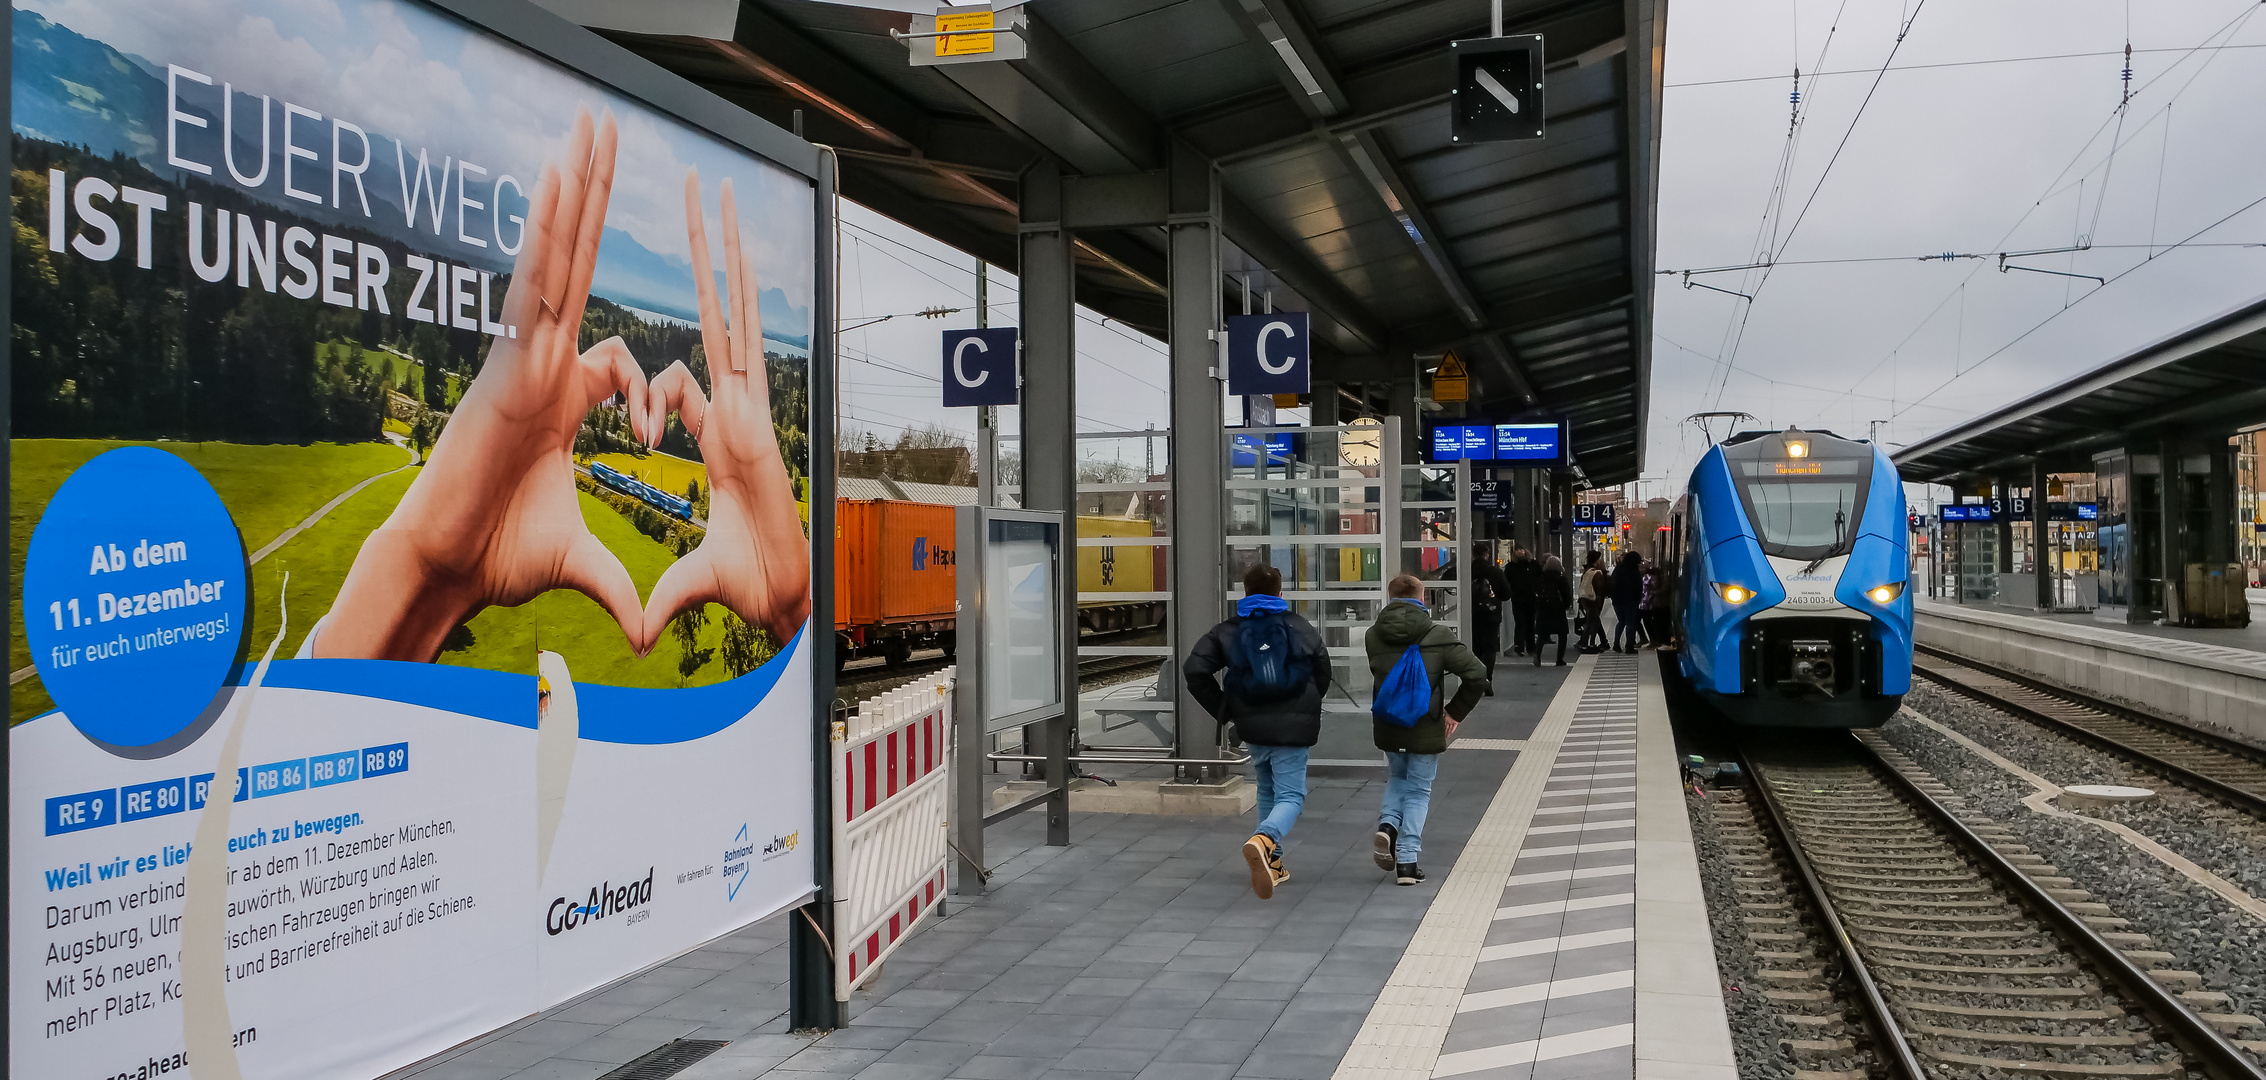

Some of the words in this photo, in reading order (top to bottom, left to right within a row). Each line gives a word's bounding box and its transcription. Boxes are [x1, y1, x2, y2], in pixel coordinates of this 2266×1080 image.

[167, 63, 372, 217] EUER
[394, 138, 526, 256] WEG
[49, 168, 168, 270] IST
[188, 202, 390, 315] UNSER
[405, 253, 517, 338] ZIEL.
[953, 336, 989, 387] C
[1257, 321, 1296, 375] C
[1486, 482, 1498, 491] 27
[1581, 505, 1591, 518] B
[1602, 505, 1611, 518] 4
[1992, 499, 2001, 513] 3
[2014, 499, 2024, 513] B
[1913, 516, 1920, 526] 3
[90, 543, 126, 575] Ab
[133, 539, 187, 568] dem
[50, 598, 91, 630] 11.
[98, 579, 225, 622] Dezember
[1787, 596, 1808, 604] 2463
[1809, 596, 1834, 604] 003-0
[51, 644, 80, 669] für
[85, 634, 130, 661] euch
[135, 613, 229, 652] unterwegs!
[314, 760, 334, 782] RB
[338, 756, 355, 776] 87
[366, 752, 384, 772] RB
[389, 748, 404, 768] 89
[256, 771, 278, 792] RB
[283, 766, 301, 786] 86
[58, 801, 86, 827] RE
[92, 798, 104, 820] 9
[127, 790, 152, 815] RE
[157, 786, 179, 809] 80
[45, 862, 92, 892] Weil
[97, 856, 130, 881] wir
[136, 854, 157, 873] es
[227, 827, 266, 853] euch
[271, 827, 289, 843] zu
[294, 812, 364, 839] bewegen.
[724, 842, 754, 863] Bahnland
[773, 829, 799, 851] bwegt
[46, 899, 112, 930] Darum
[118, 876, 186, 911] verbind
[226, 866, 238, 886] ir
[243, 860, 261, 883] ab
[266, 855, 299, 877] dem
[304, 846, 322, 867] 11.
[327, 832, 395, 862] Dezember
[399, 819, 456, 845] München,
[676, 872, 687, 885] Wir
[687, 867, 704, 882] fahren
[723, 861, 745, 878] Bayern
[45, 926, 143, 966] Augsburg,
[227, 884, 295, 918] auwörth,
[300, 867, 368, 900] Würzburg
[372, 857, 396, 880] und
[400, 851, 438, 873] Aalen.
[626, 908, 651, 927] BAYERN
[46, 974, 76, 1002] Mit
[83, 964, 105, 992] 56
[112, 953, 172, 984] neuen,
[225, 921, 277, 951] ischen
[282, 897, 365, 936] Fahrzeugen
[369, 884, 417, 910] bringen
[421, 874, 441, 895] wir
[46, 1006, 99, 1039] mehr
[105, 991, 155, 1022] Platz,
[236, 952, 265, 980] und
[270, 920, 379, 970] Barrierefreiheit
[382, 911, 403, 936] auf
[406, 908, 425, 928] die
[428, 894, 477, 920] Schiene.
